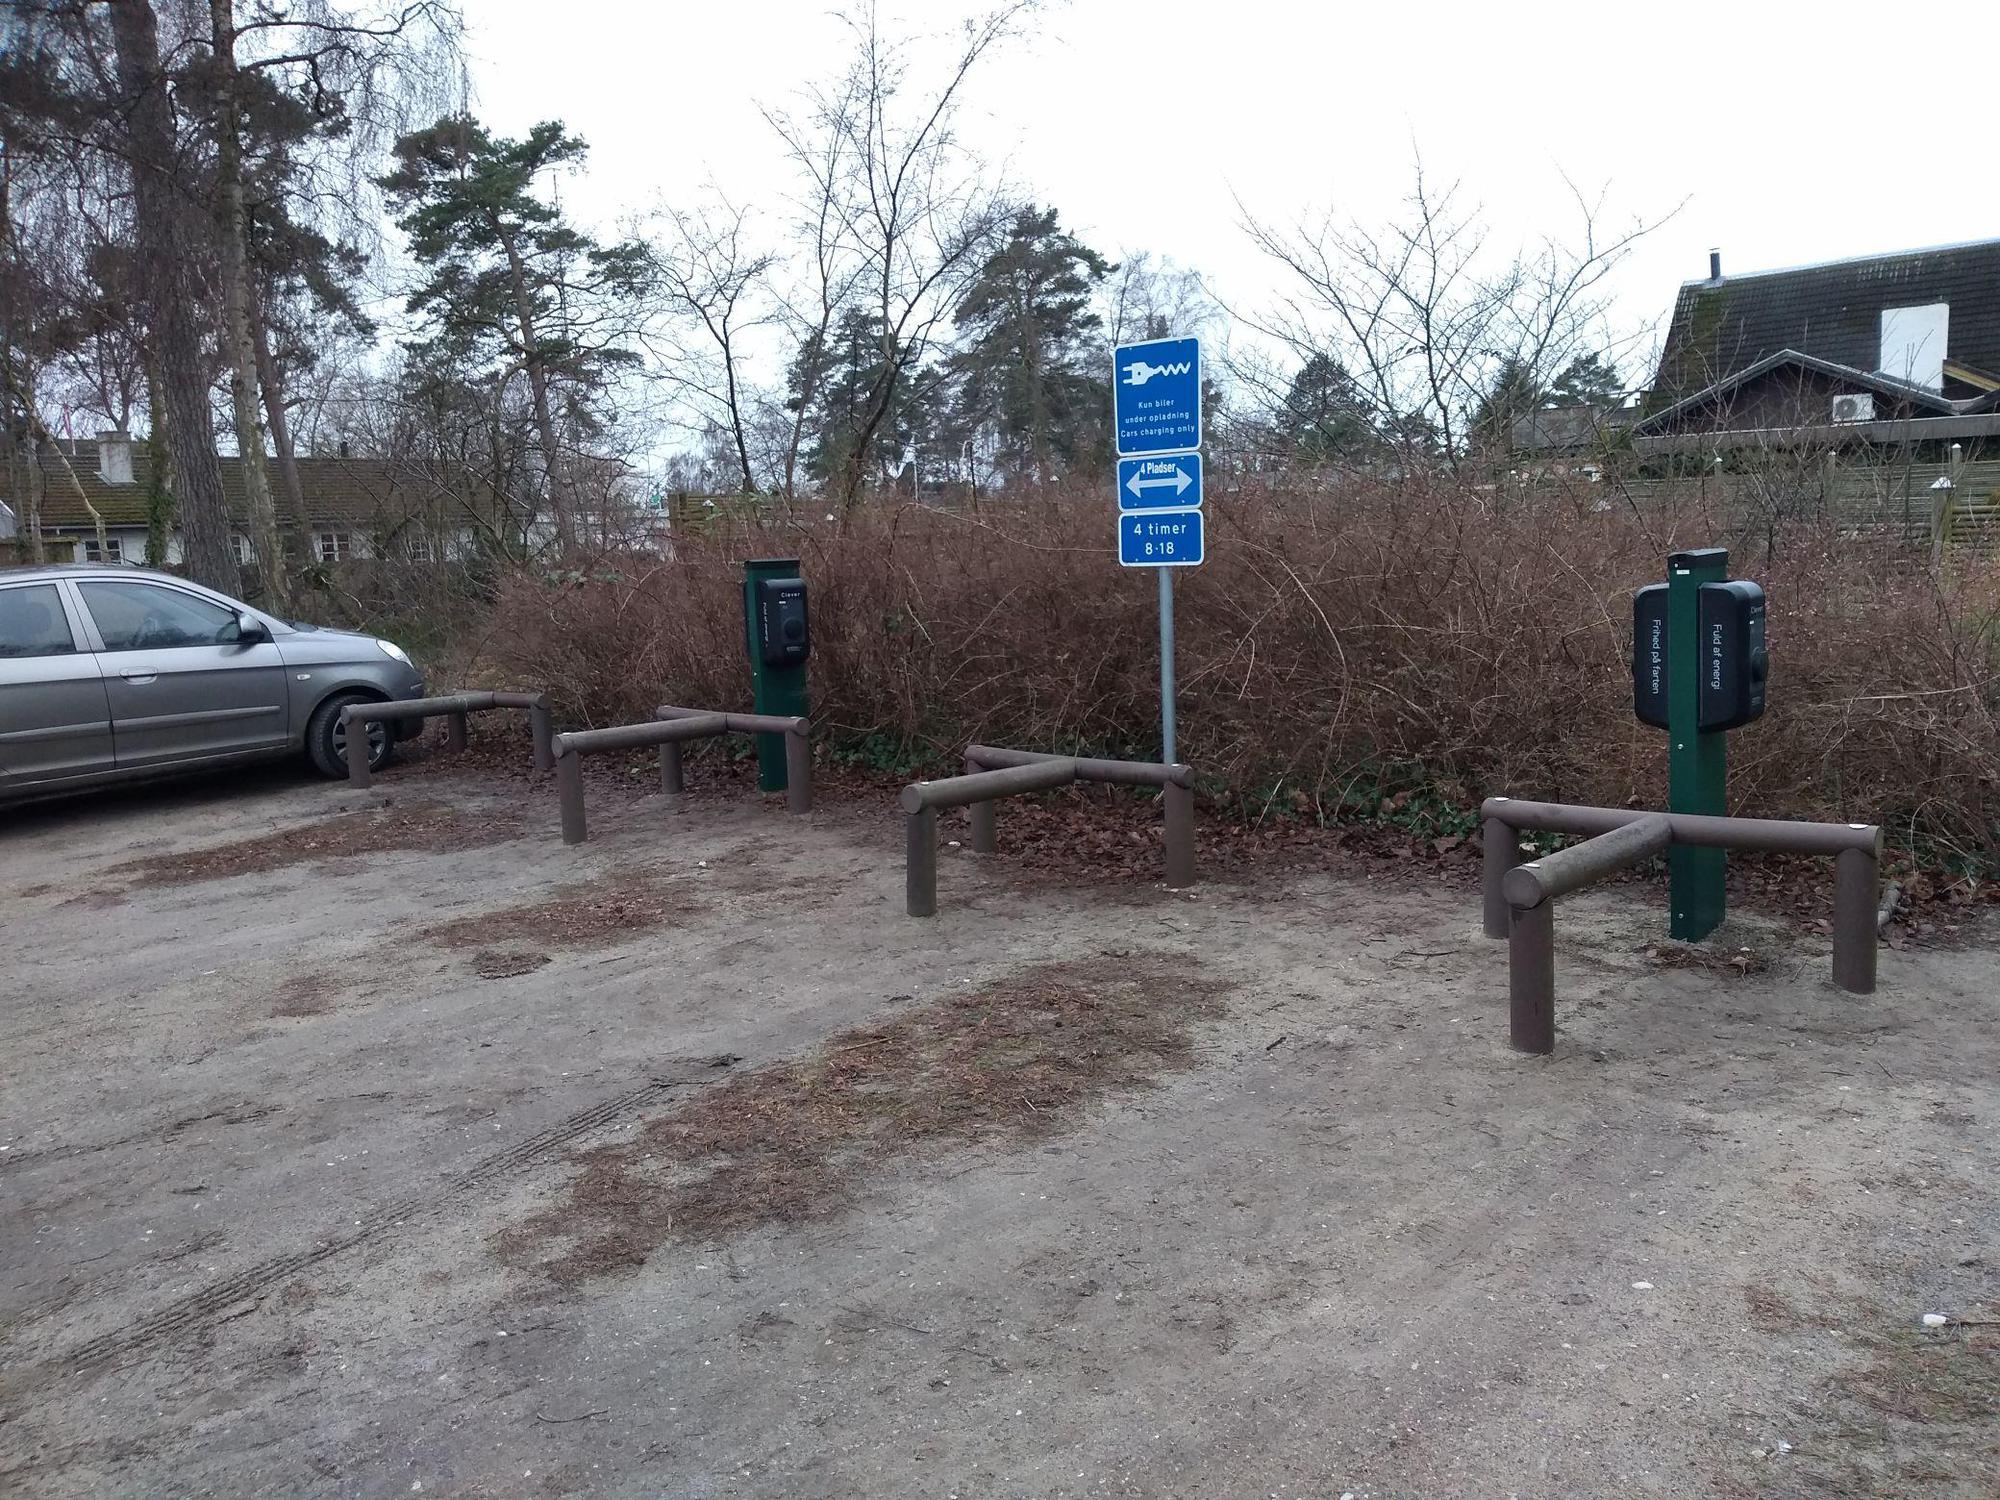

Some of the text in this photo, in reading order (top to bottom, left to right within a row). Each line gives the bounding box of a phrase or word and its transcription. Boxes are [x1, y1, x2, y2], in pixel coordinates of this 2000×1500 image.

[1155, 399, 1175, 407] biler
[1125, 411, 1189, 424] under opladning
[1120, 424, 1195, 438] Cars charging only
[1140, 461, 1175, 474] 4 Pladser
[1134, 522, 1186, 535] 4 timer
[1650, 619, 1661, 694] Frihed på farten
[1711, 624, 1722, 689] Fuld af energi
